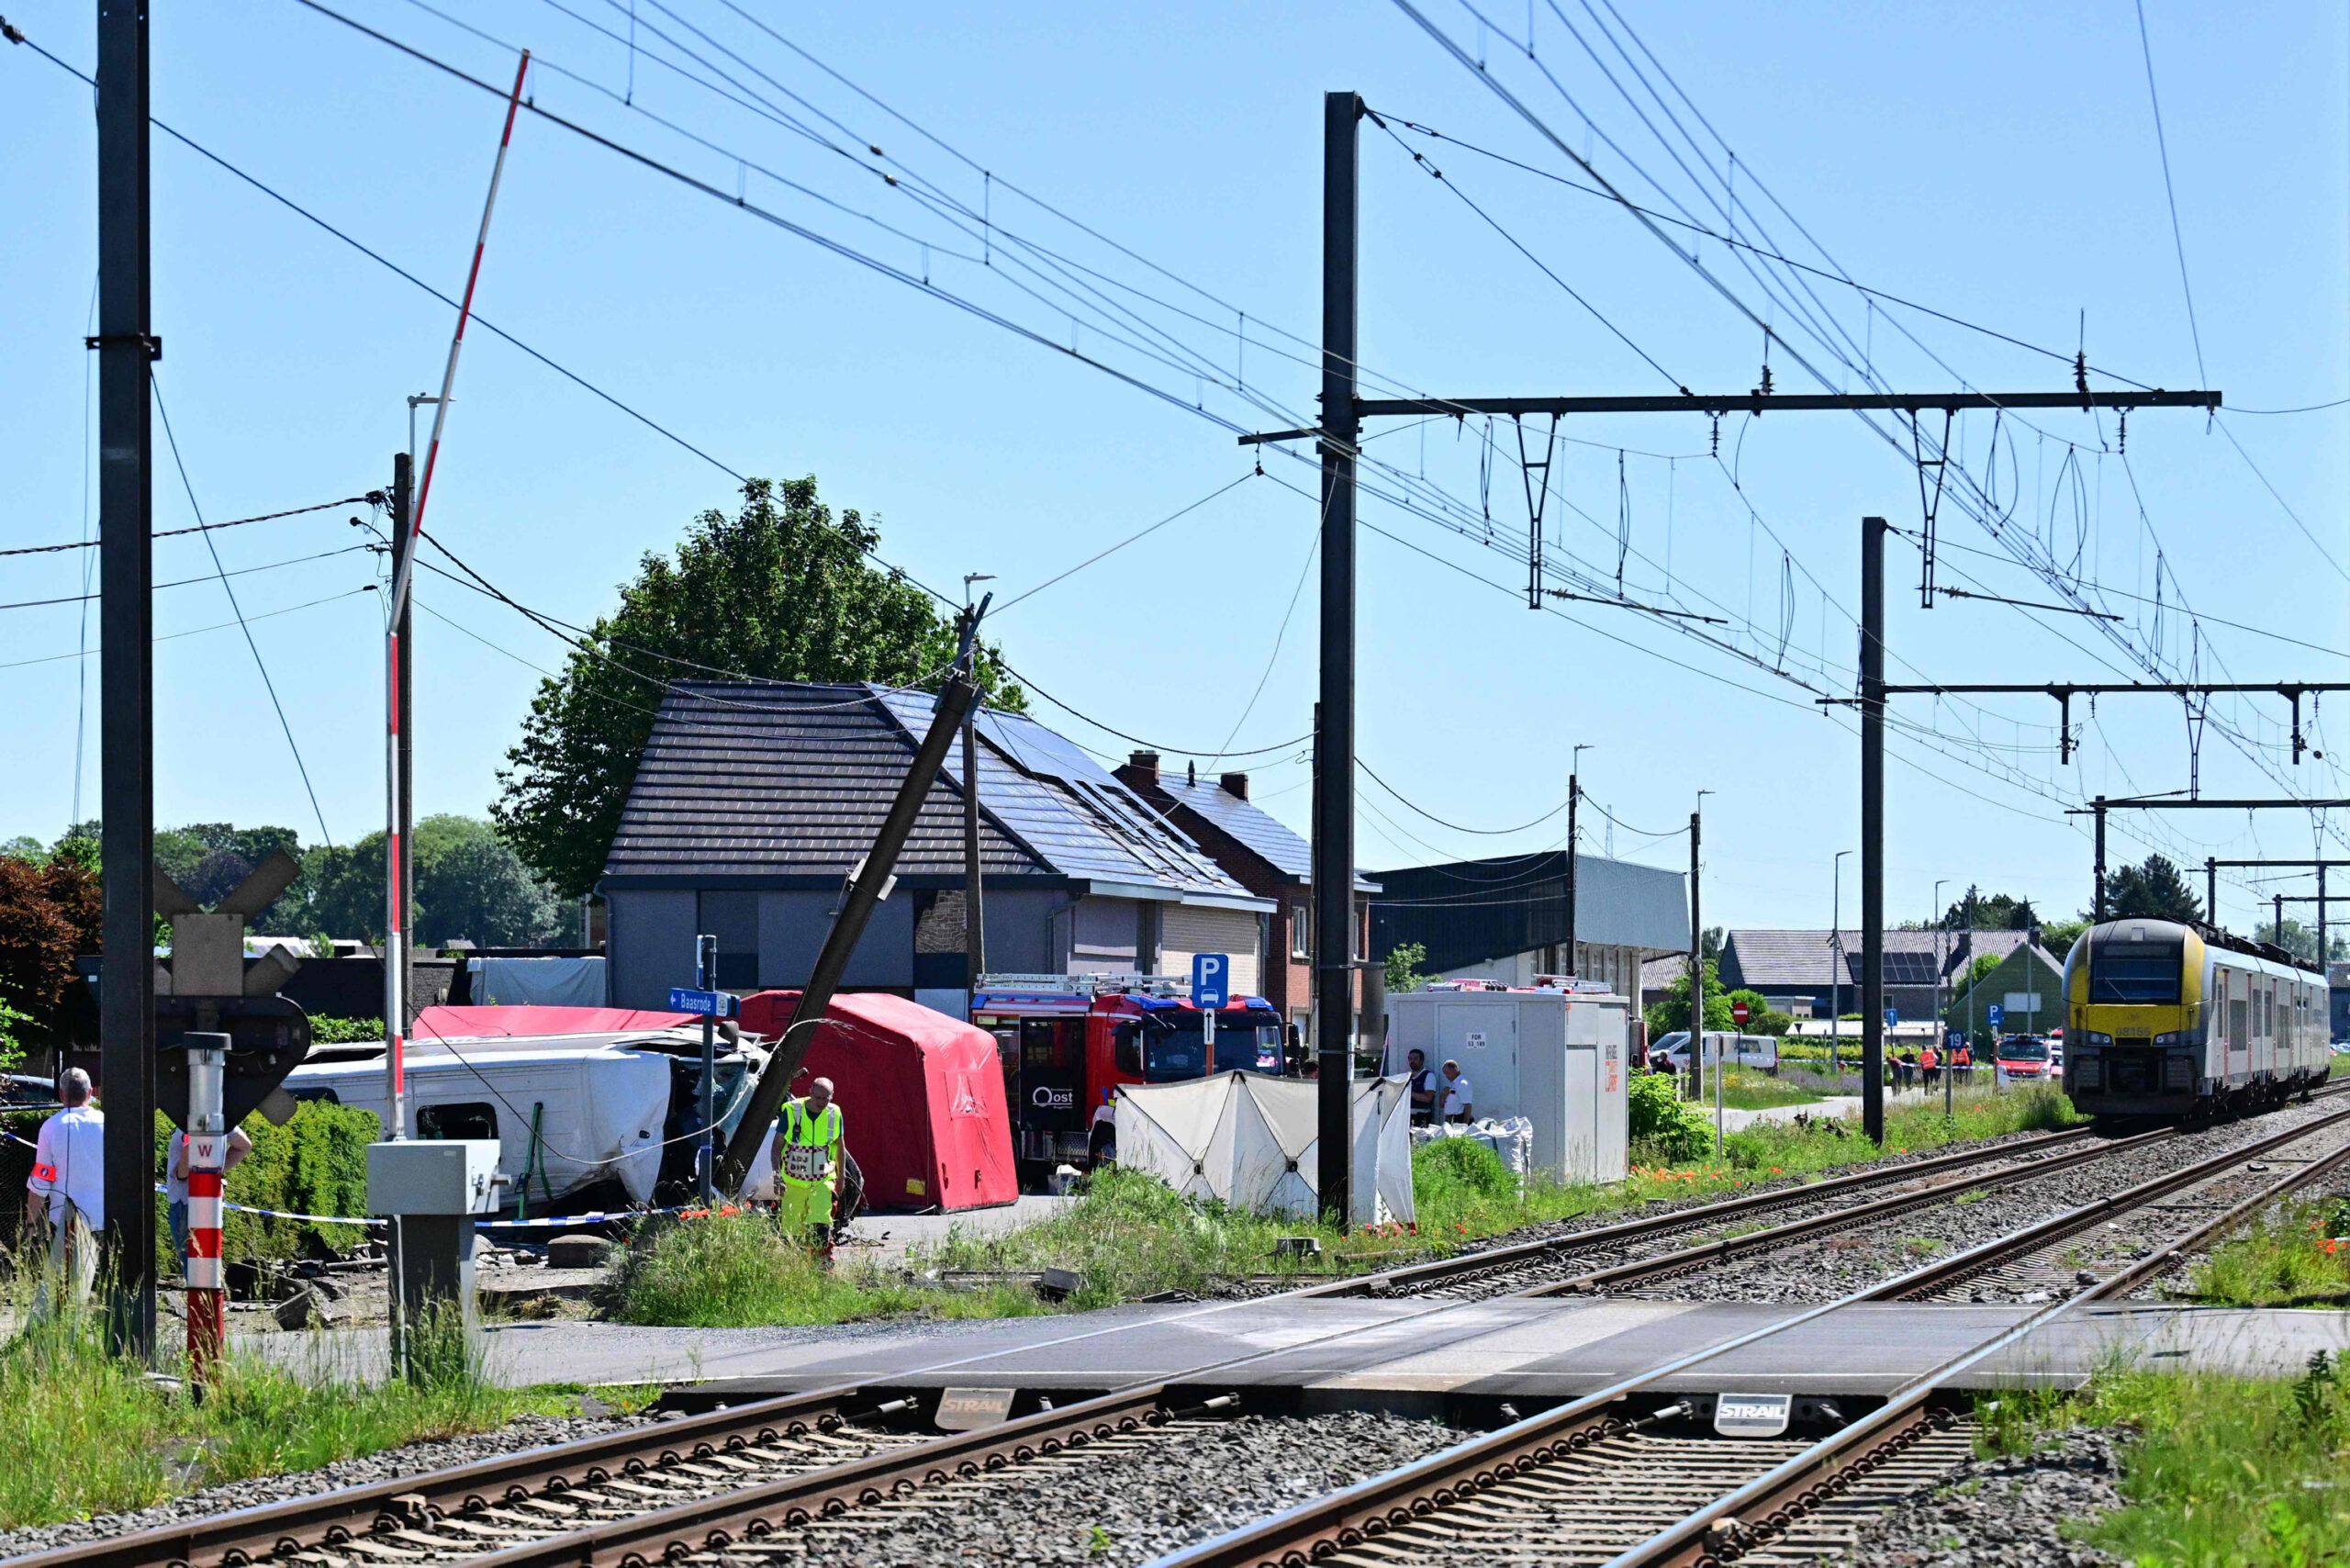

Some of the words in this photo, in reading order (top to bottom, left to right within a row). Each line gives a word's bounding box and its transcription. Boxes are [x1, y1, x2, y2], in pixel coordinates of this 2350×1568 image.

[1201, 958, 1220, 986] P
[680, 992, 711, 1012] Baasrode
[1989, 1005, 1998, 1017] P
[1948, 1033, 1962, 1047] 19
[1032, 1087, 1073, 1107] Oost
[198, 1145, 212, 1157] W
[944, 1400, 1003, 1414] STRAIL
[1719, 1406, 1785, 1417] STRAIL
